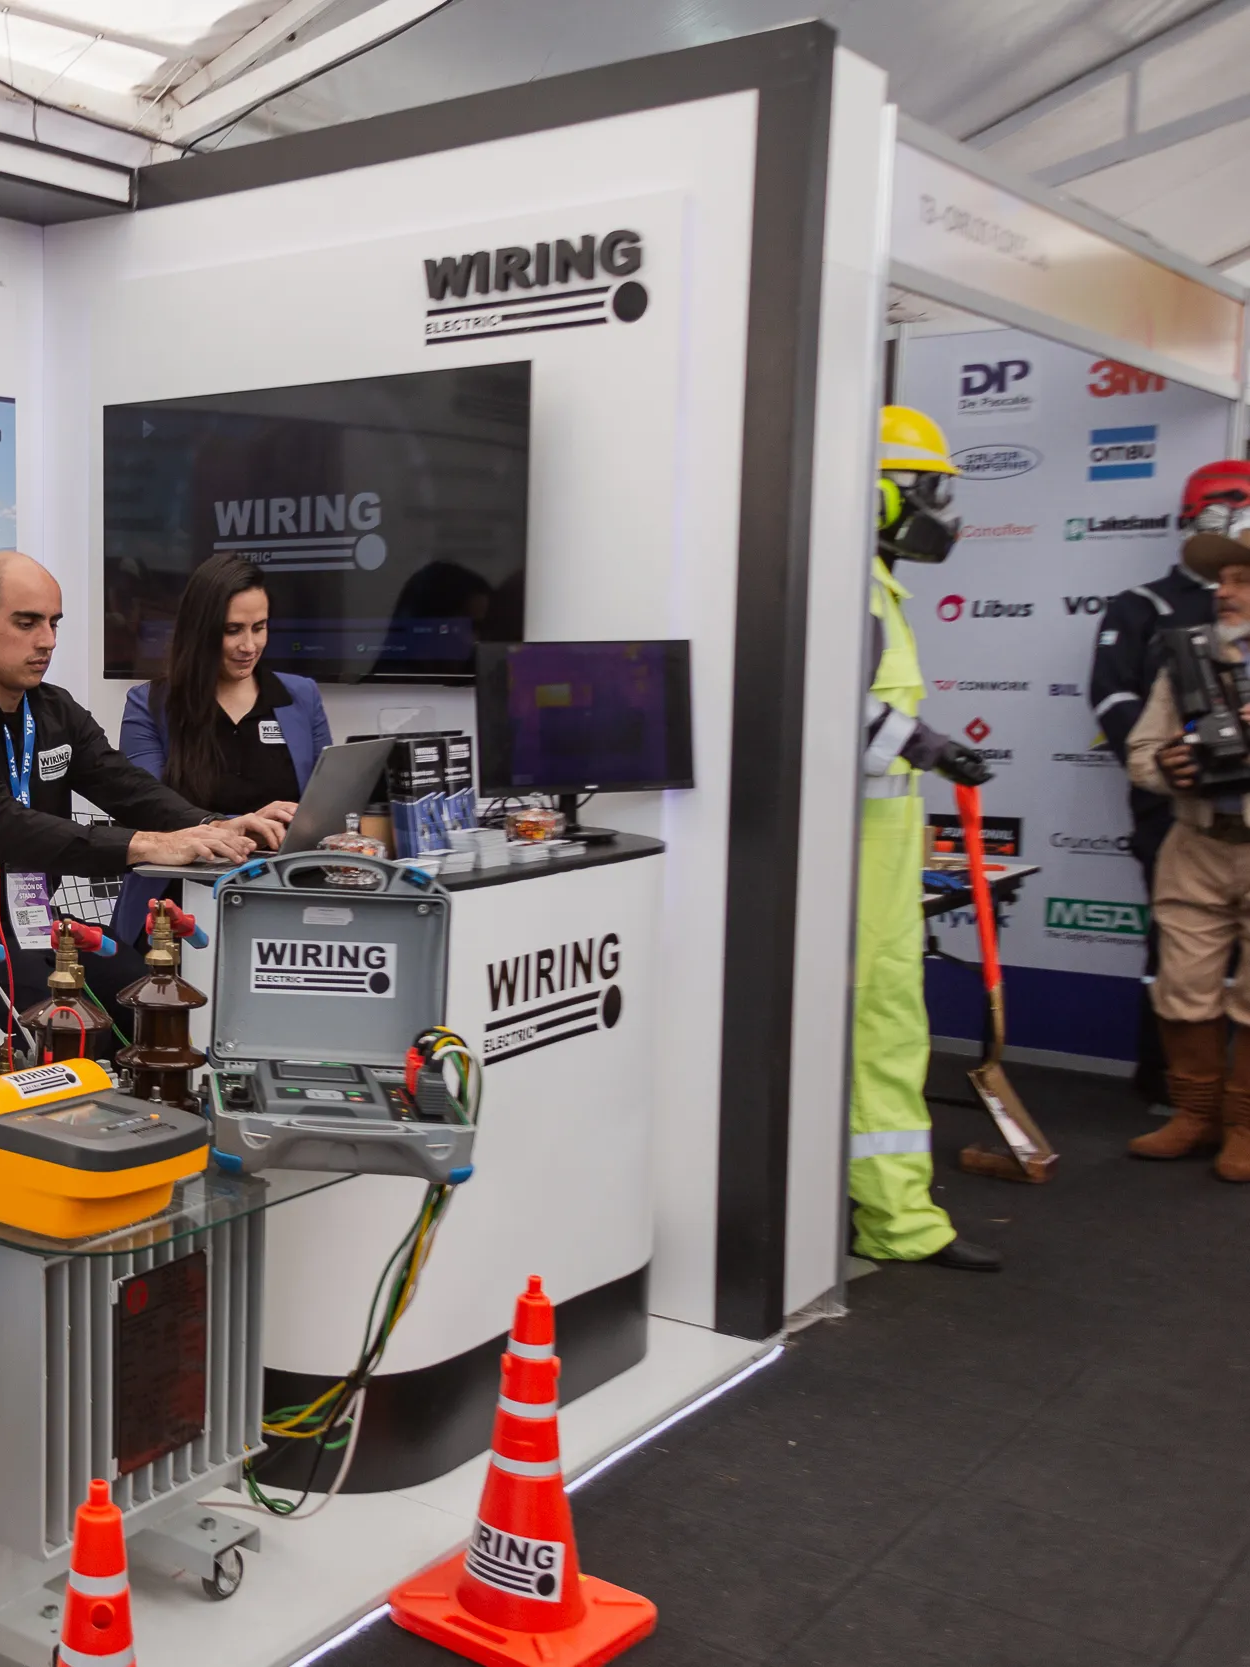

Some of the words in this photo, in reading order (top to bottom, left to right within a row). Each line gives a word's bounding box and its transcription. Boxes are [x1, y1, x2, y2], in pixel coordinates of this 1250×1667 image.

[424, 229, 643, 300] WIRING
[425, 314, 500, 335] ELECTRIC
[961, 360, 1032, 397] DP
[1087, 359, 1167, 398] 3M
[214, 491, 383, 536] WIRING
[237, 551, 271, 563] TRIC
[971, 599, 1034, 618] Libus
[23, 752, 31, 774] YPF
[40, 751, 70, 767] WIRING
[1049, 901, 1144, 931] MSA
[256, 942, 387, 970] WIRING
[255, 974, 302, 984] ELECTRIC
[487, 932, 620, 1012] WIRING
[8, 1065, 67, 1083] WIRING
[478, 1524, 555, 1570] RING
